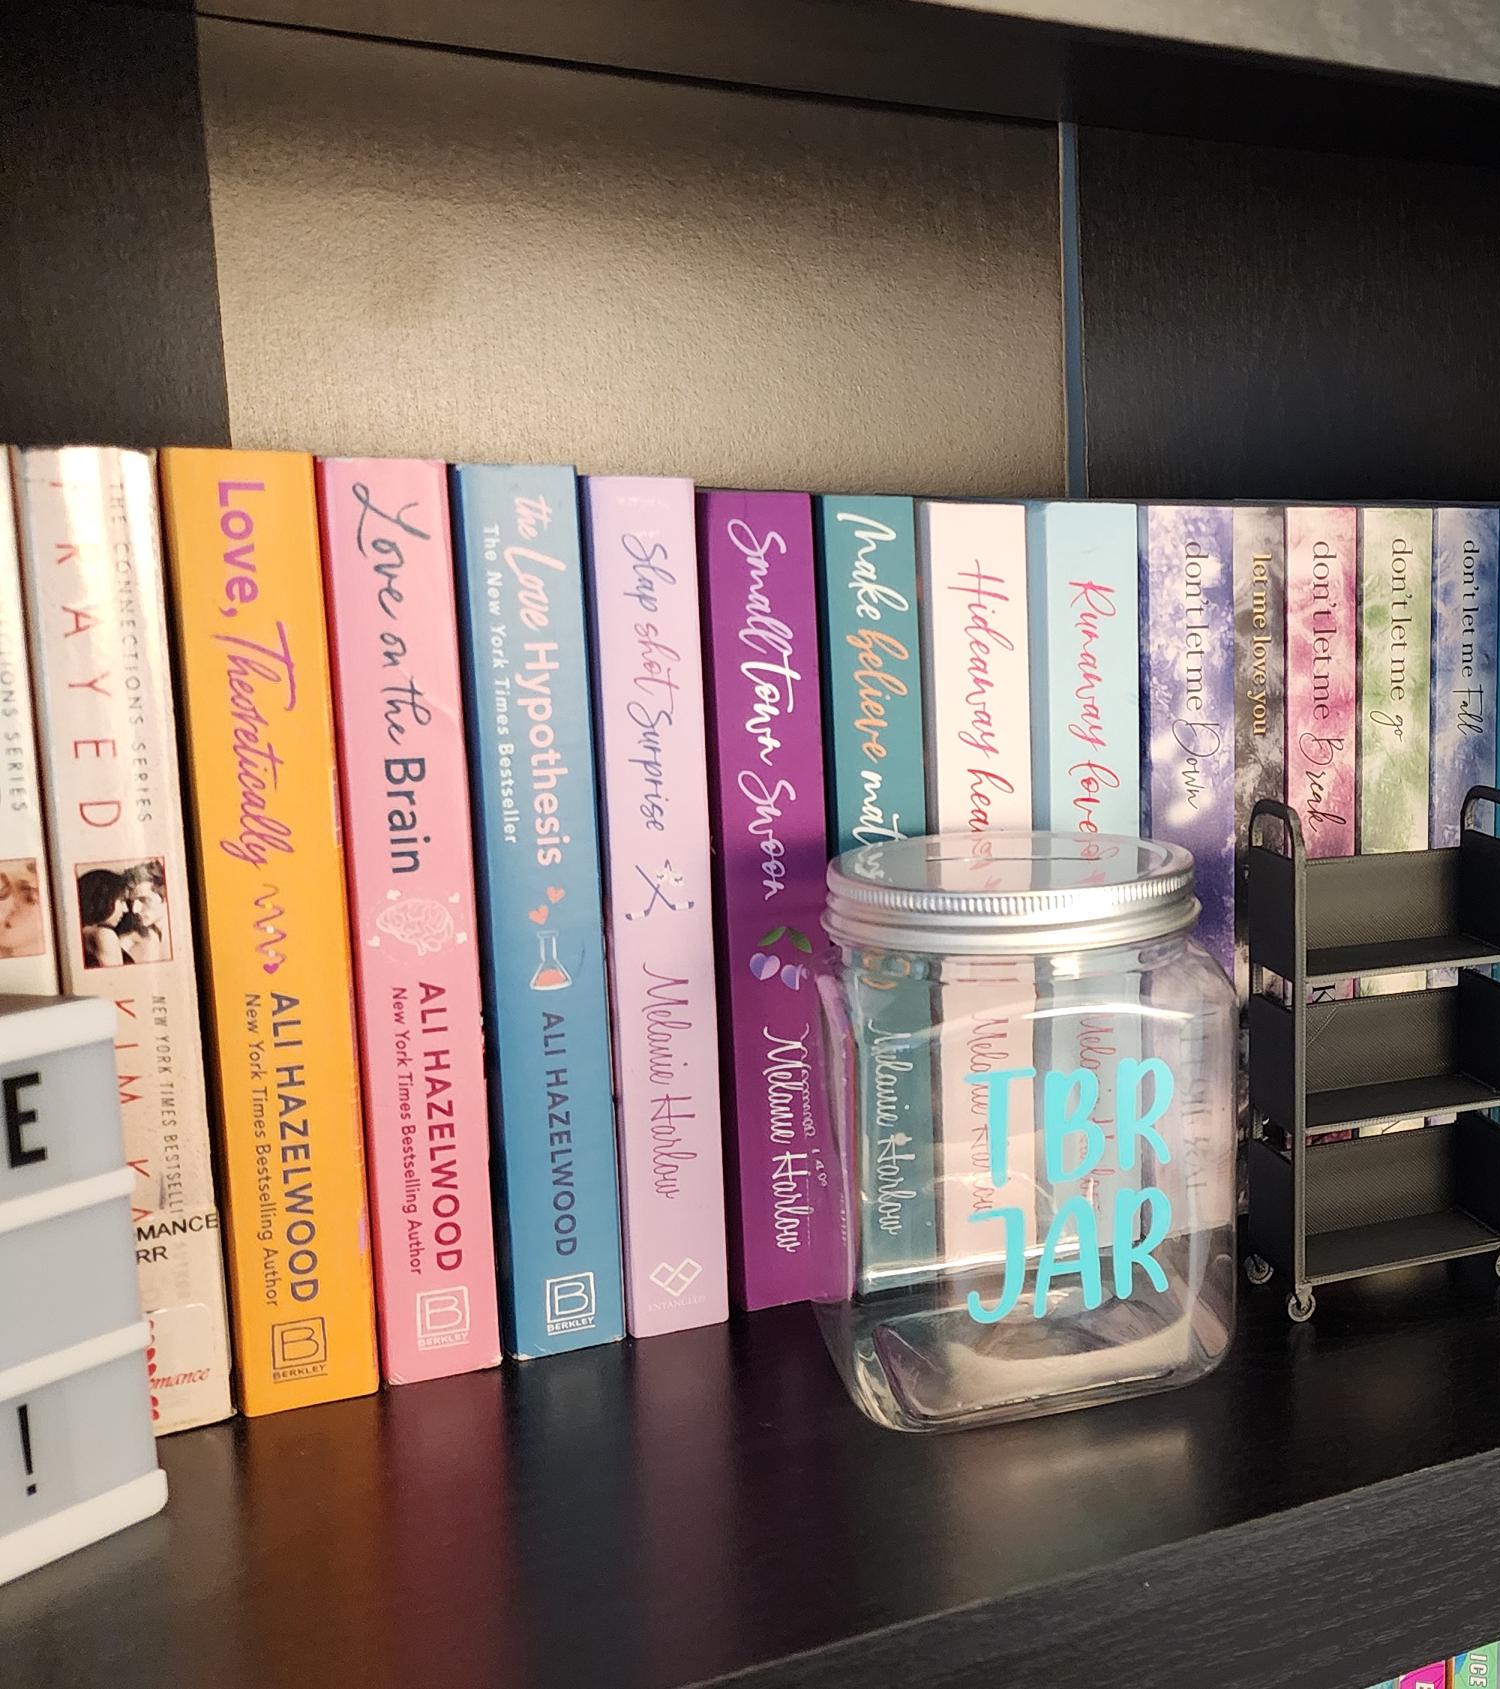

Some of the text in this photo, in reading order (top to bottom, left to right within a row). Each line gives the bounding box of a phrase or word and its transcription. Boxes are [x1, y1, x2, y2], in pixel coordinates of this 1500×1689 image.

[50, 478, 121, 827] AYED
[211, 481, 296, 870] Love, Theoretically
[353, 482, 431, 875] Love on the Brain
[481, 523, 520, 844] The New York Times Bestseller
[503, 496, 570, 867] the Love Hypothesis
[622, 533, 680, 832] Slap shot Surprise
[727, 518, 794, 655] Small
[837, 512, 909, 847] Make believe mat
[947, 559, 1014, 759] Hideaway
[1068, 580, 1116, 750] Runaway
[1171, 540, 1221, 810] don't let me Down
[1247, 554, 1272, 736] let me love you
[1300, 540, 1346, 832] don't let me Break
[1370, 538, 1413, 743] don't let me go
[1453, 539, 1484, 736] don't let me Fall
[4, 731, 28, 812] SERIES
[132, 742, 152, 823] SERIES
[738, 770, 796, 900] Swoon
[2, 1072, 47, 1168] E
[152, 995, 183, 1213] NEW YORK TIMES BESTSELLI
[244, 993, 279, 1307] New York Times Bestselling Author
[270, 992, 319, 1304] ALI HAZELWOOD
[391, 987, 422, 1275] New York Times Bestselling Author
[417, 981, 463, 1271] ALI HAZELWOOD
[542, 1011, 577, 1256] ALI HAZELWOOD
[642, 962, 698, 1199] Melanie Harlow
[762, 1026, 808, 1253] Melanie Harlow
[964, 1057, 1174, 1187] TBR
[136, 1213, 219, 1242] MANCE
[136, 1245, 168, 1264] RR
[877, 1135, 916, 1235] Harlow
[966, 1187, 1172, 1323] JAR
[149, 1368, 210, 1389] mance
[272, 1364, 327, 1381] BERKLEY
[417, 1333, 469, 1348] BERKLEY
[547, 1316, 596, 1332] BERKLEY
[17, 1404, 38, 1496] !
